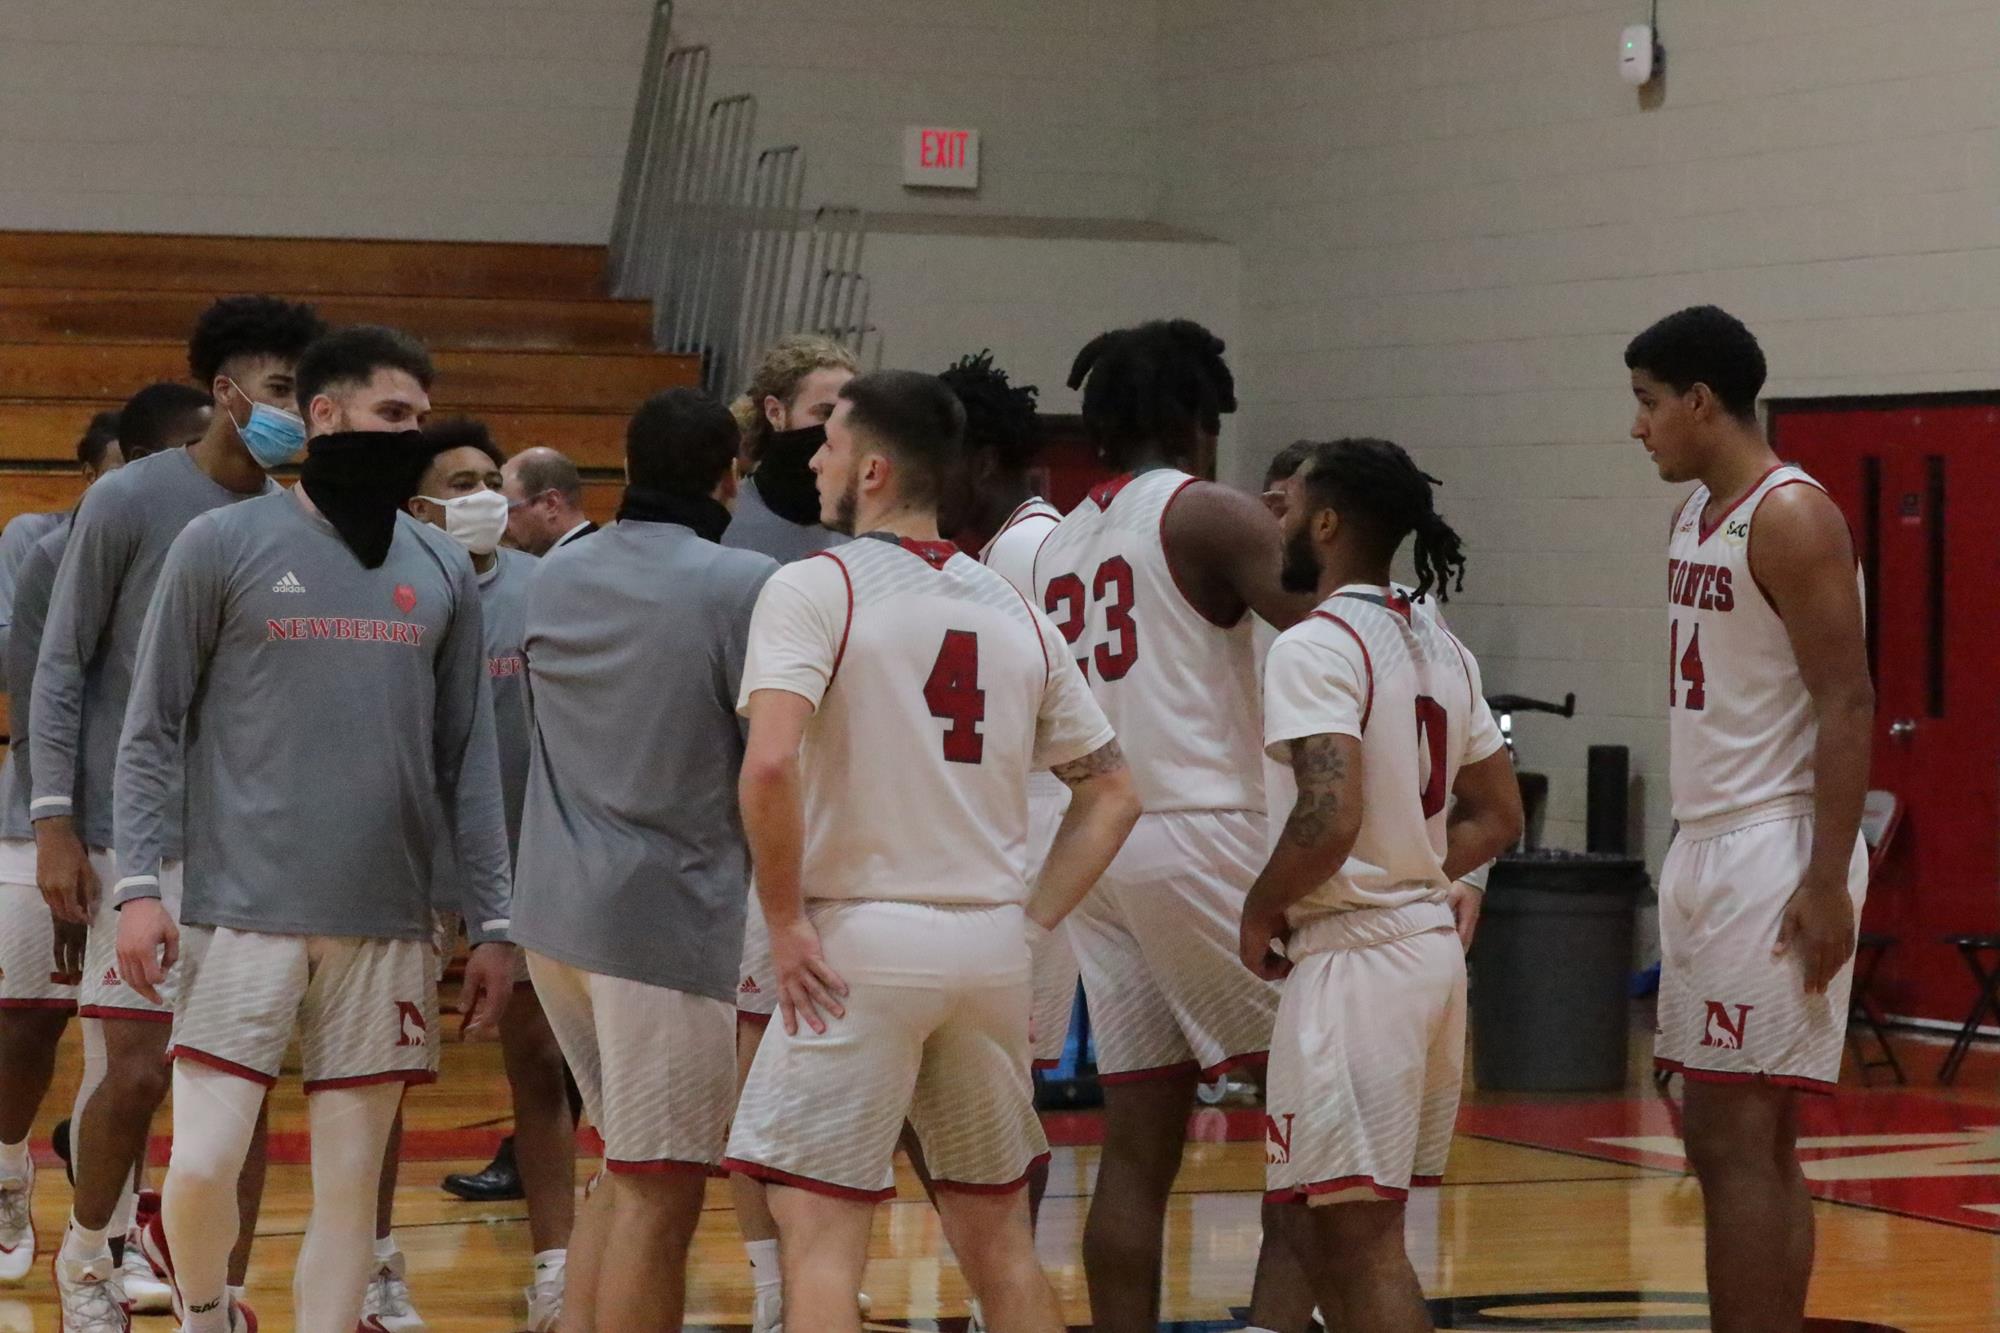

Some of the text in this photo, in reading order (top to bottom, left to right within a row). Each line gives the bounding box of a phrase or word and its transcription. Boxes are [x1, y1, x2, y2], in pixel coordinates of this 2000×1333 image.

[921, 129, 968, 168] EXIT
[272, 584, 306, 593] adidas
[266, 617, 427, 646] NEWBERRY
[1045, 554, 1139, 682] 23
[1670, 618, 1706, 711] 14
[923, 629, 985, 765] 4
[1700, 1000, 1755, 1051] N
